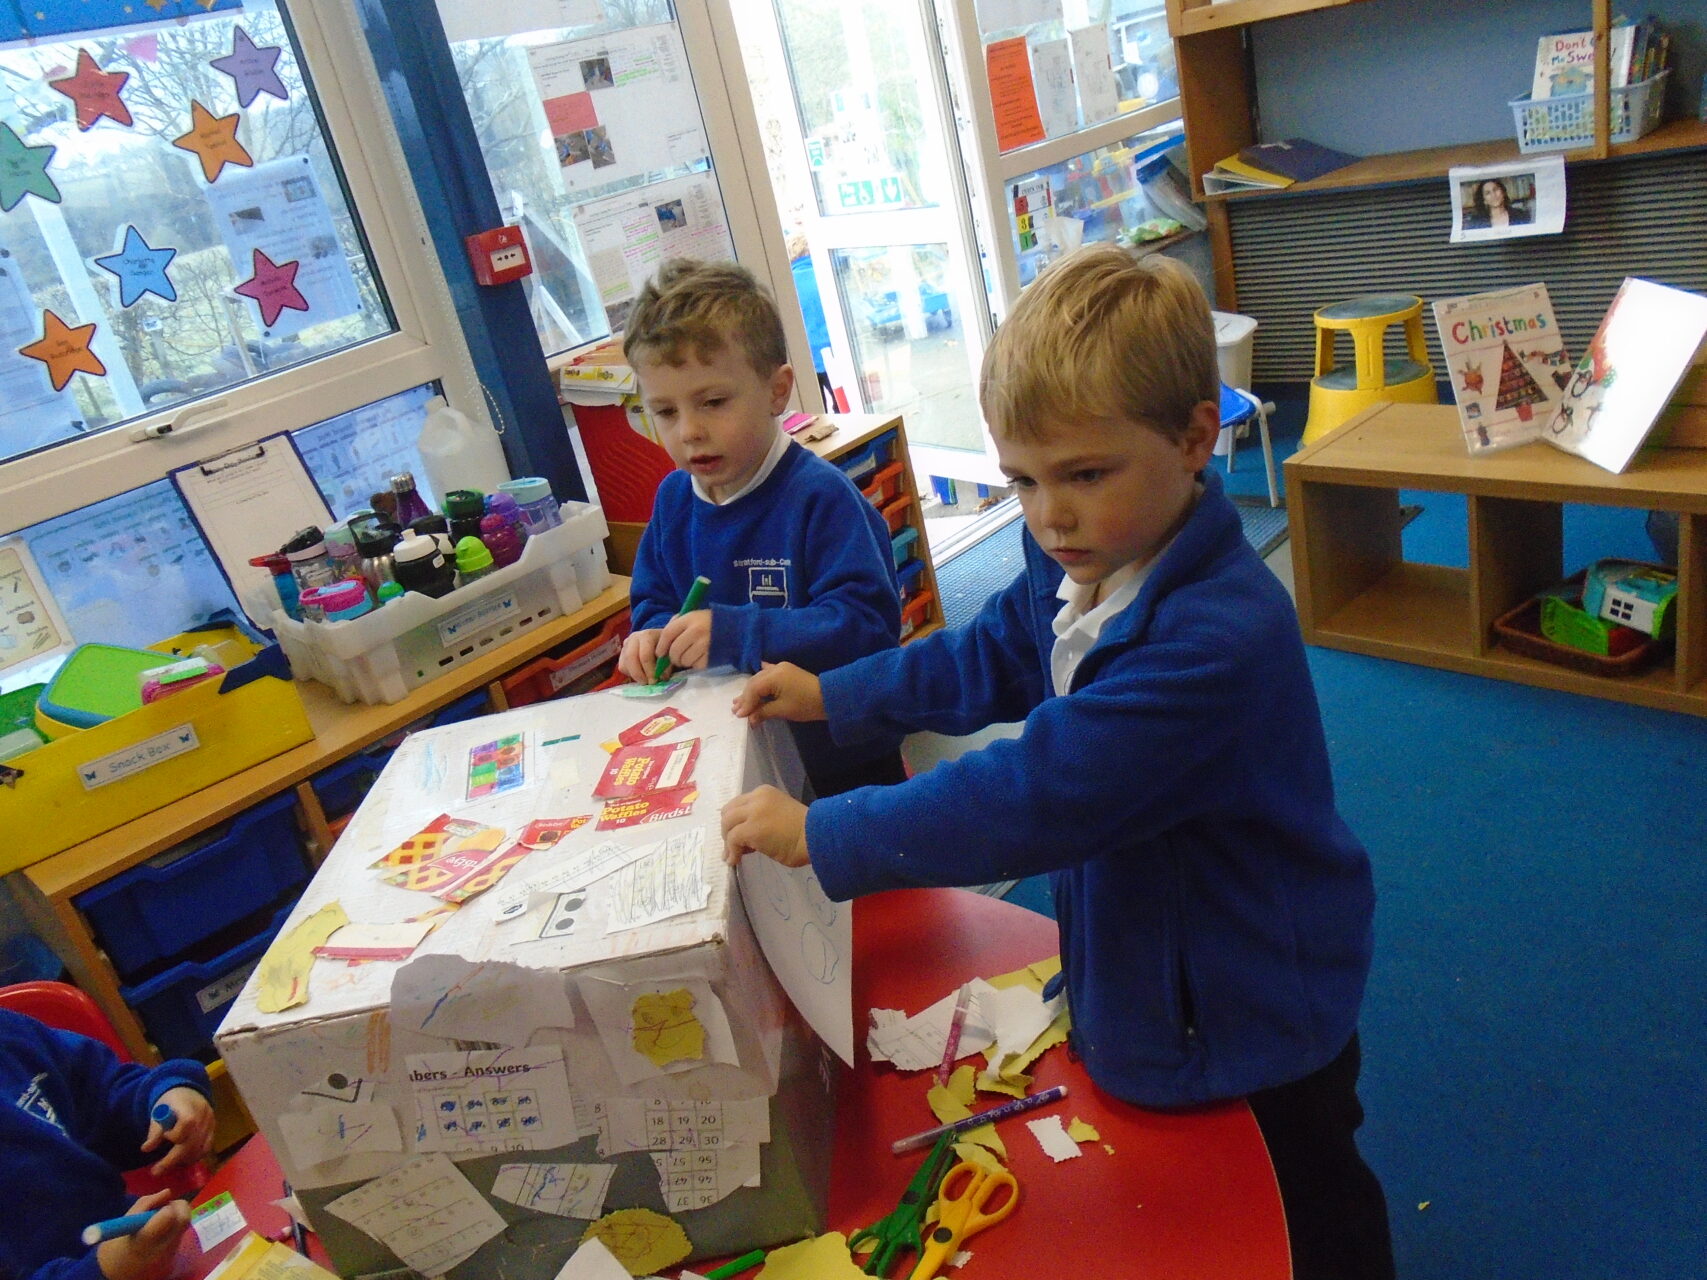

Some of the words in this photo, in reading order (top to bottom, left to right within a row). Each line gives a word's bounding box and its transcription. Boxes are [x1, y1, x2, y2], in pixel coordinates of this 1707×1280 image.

[1020, 217, 1027, 230] 3
[1452, 313, 1547, 344] Christmas
[108, 751, 144, 773] Snack
[147, 743, 171, 757] Box
[603, 802, 650, 815] Potato
[600, 809, 648, 822] Waffles
[464, 1063, 531, 1078] Answers
[677, 1117, 690, 1125] 19
[701, 1116, 716, 1125] 20
[652, 1137, 667, 1145] 28
[679, 1136, 693, 1145] 29
[704, 1136, 719, 1145] 30
[673, 1157, 686, 1166] 57
[674, 1176, 687, 1185] 47
